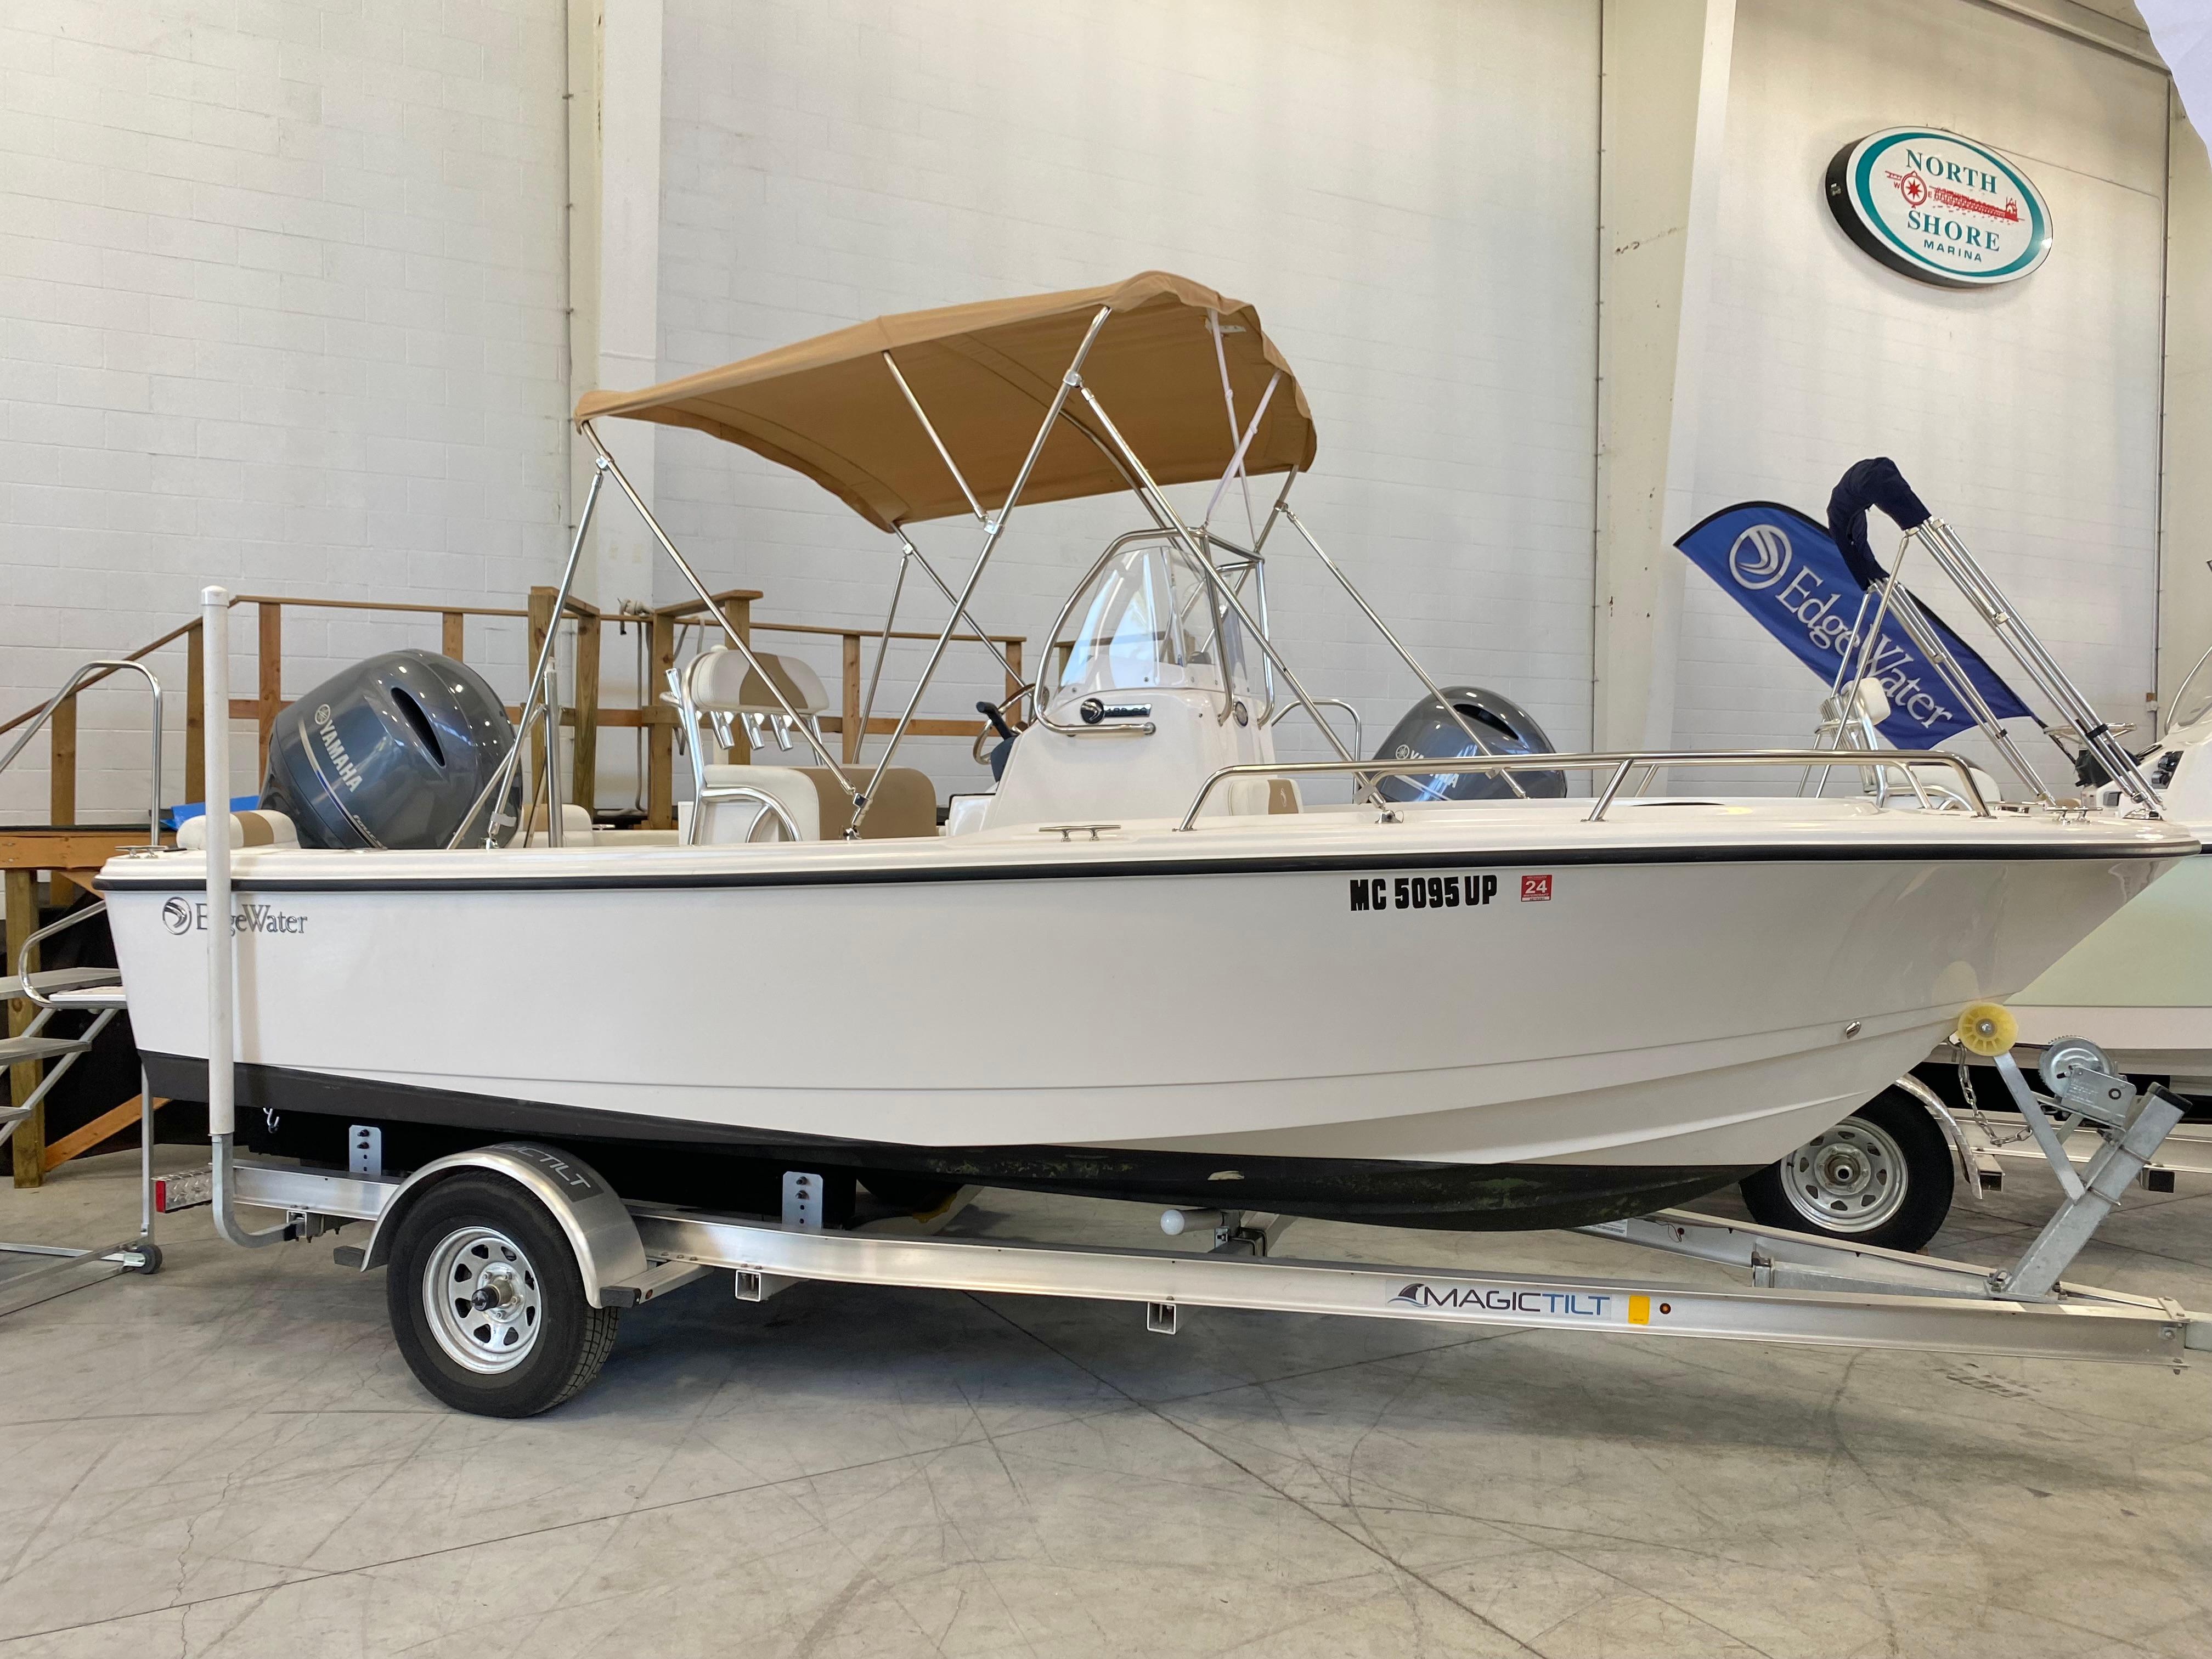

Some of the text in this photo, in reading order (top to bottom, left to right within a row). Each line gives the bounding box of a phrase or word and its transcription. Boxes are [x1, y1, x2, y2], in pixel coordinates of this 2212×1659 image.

[1906, 149, 1997, 194] NORTH
[1907, 210, 2000, 252] SHORE
[1923, 239, 1982, 262] MARINA
[320, 719, 363, 793] YAMAHA
[1350, 874, 1497, 911] MC 5095 UP
[1525, 879, 1548, 894] 24
[195, 903, 308, 937] EeWater
[492, 1143, 591, 1189] GICTILT
[1424, 1286, 1611, 1316] MAGICTILT
